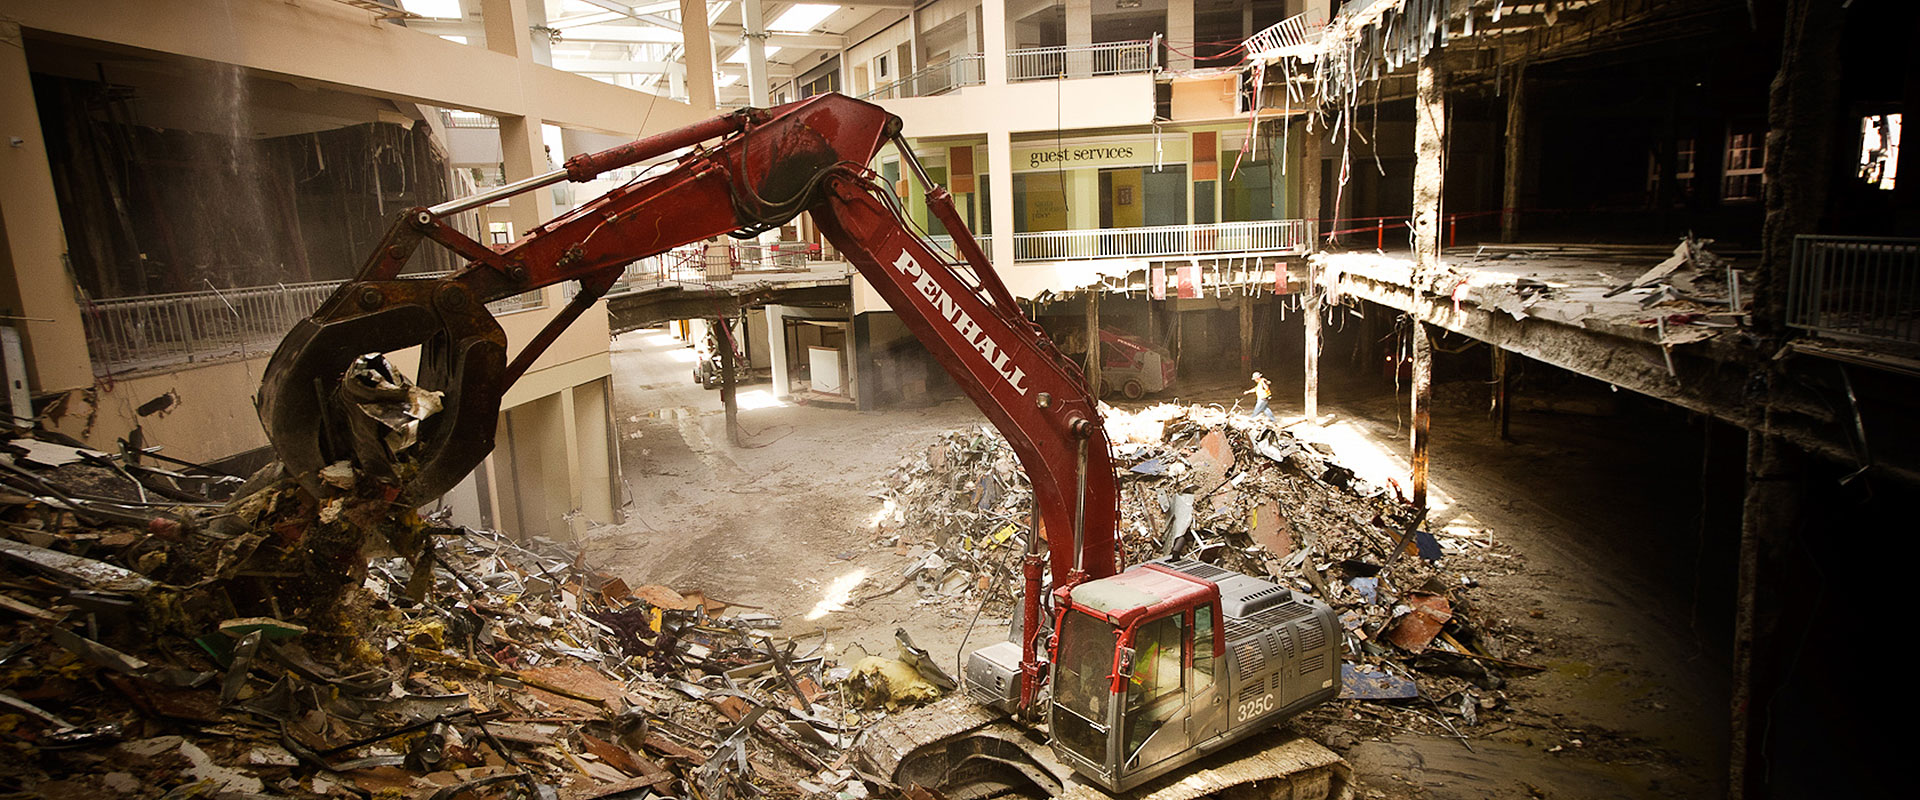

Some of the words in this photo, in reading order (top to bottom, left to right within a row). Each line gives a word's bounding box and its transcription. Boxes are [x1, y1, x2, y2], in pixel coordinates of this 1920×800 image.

[1030, 148, 1070, 168] guest
[1073, 147, 1133, 160] services
[892, 248, 1028, 396] PENHALL
[1237, 693, 1274, 722] 325C
